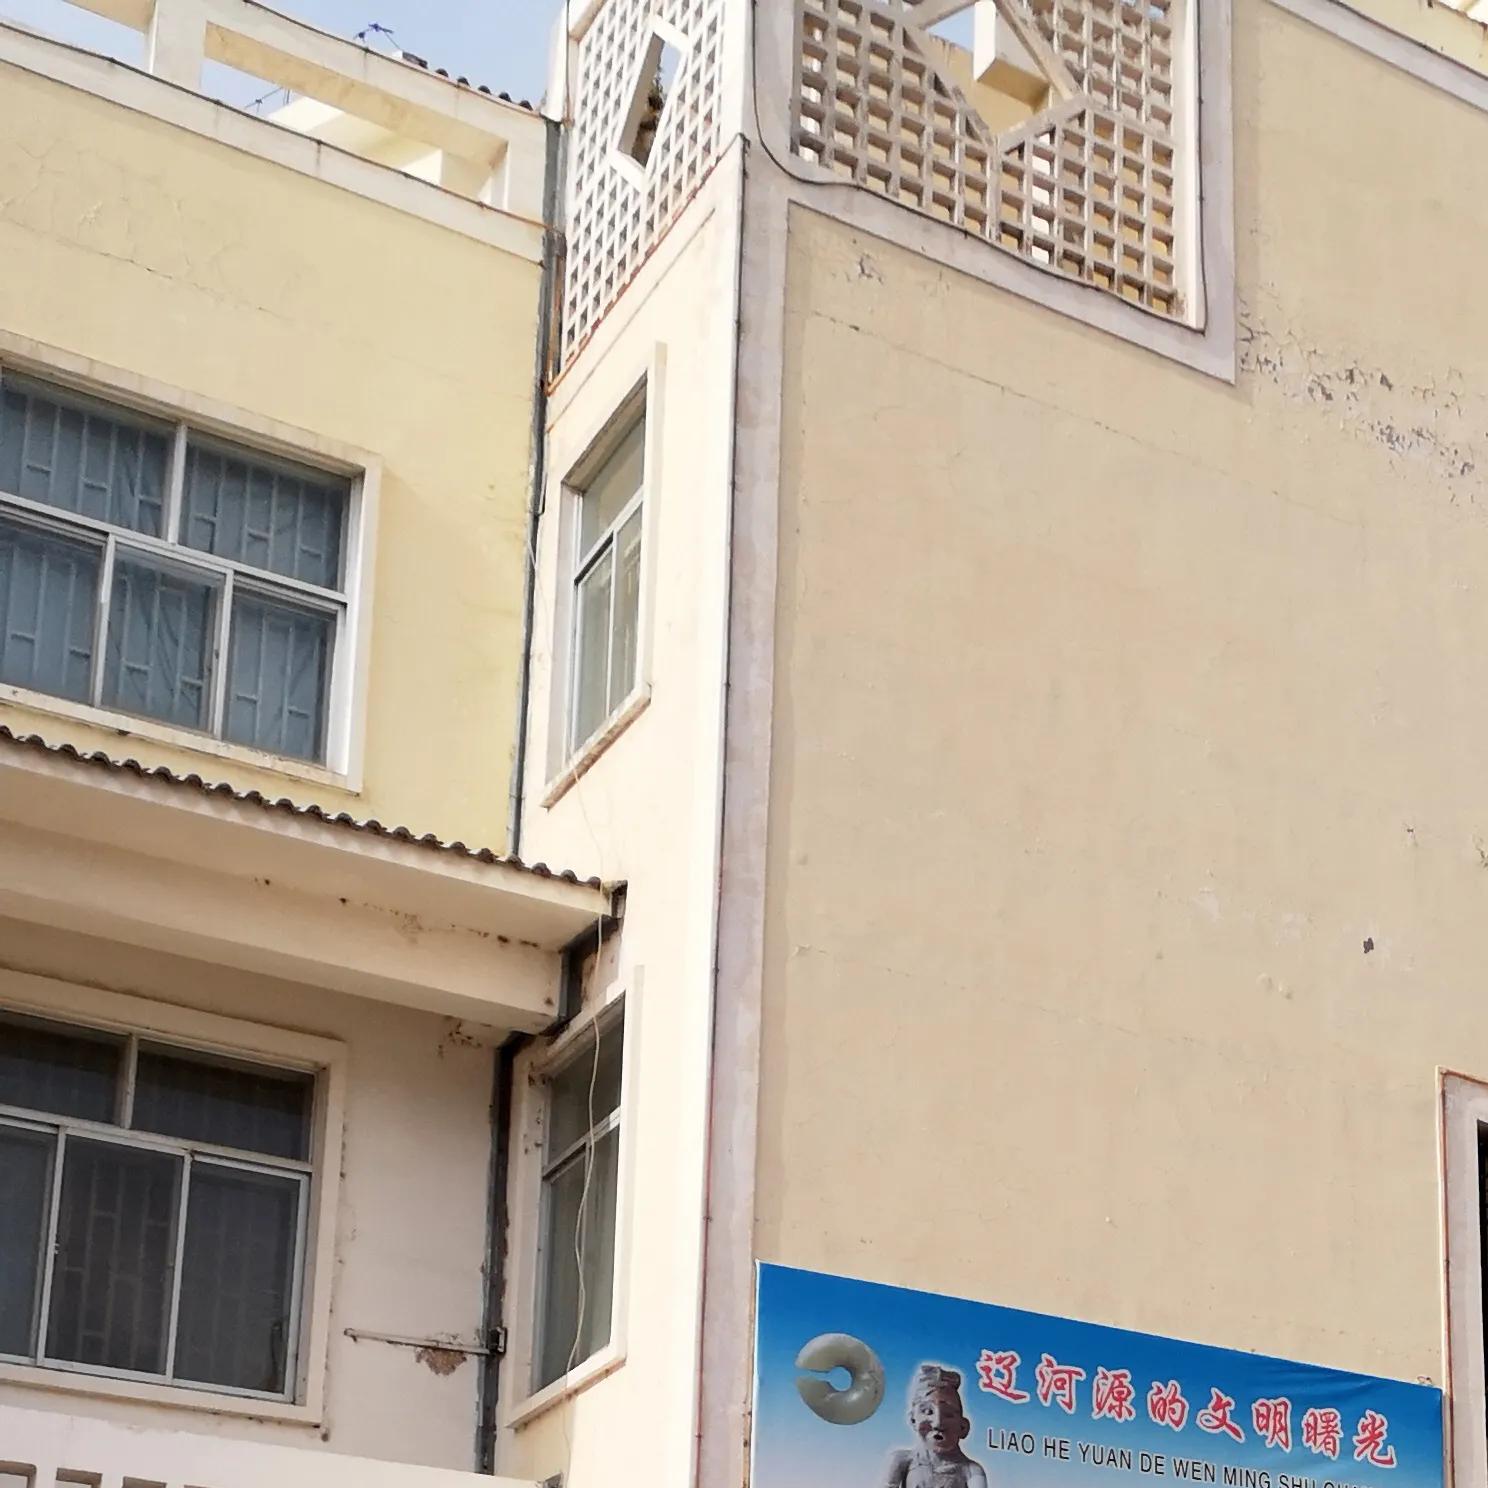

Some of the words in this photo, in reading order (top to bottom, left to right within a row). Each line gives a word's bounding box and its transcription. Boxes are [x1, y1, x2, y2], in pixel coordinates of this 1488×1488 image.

[977, 1348, 1398, 1468] 辽河源的文明曙光
[988, 1428, 1035, 1455] LIAO
[1044, 1437, 1070, 1460] HE
[1078, 1442, 1132, 1470] YUAN
[1140, 1453, 1165, 1475] DE
[1173, 1458, 1216, 1483] WEN
